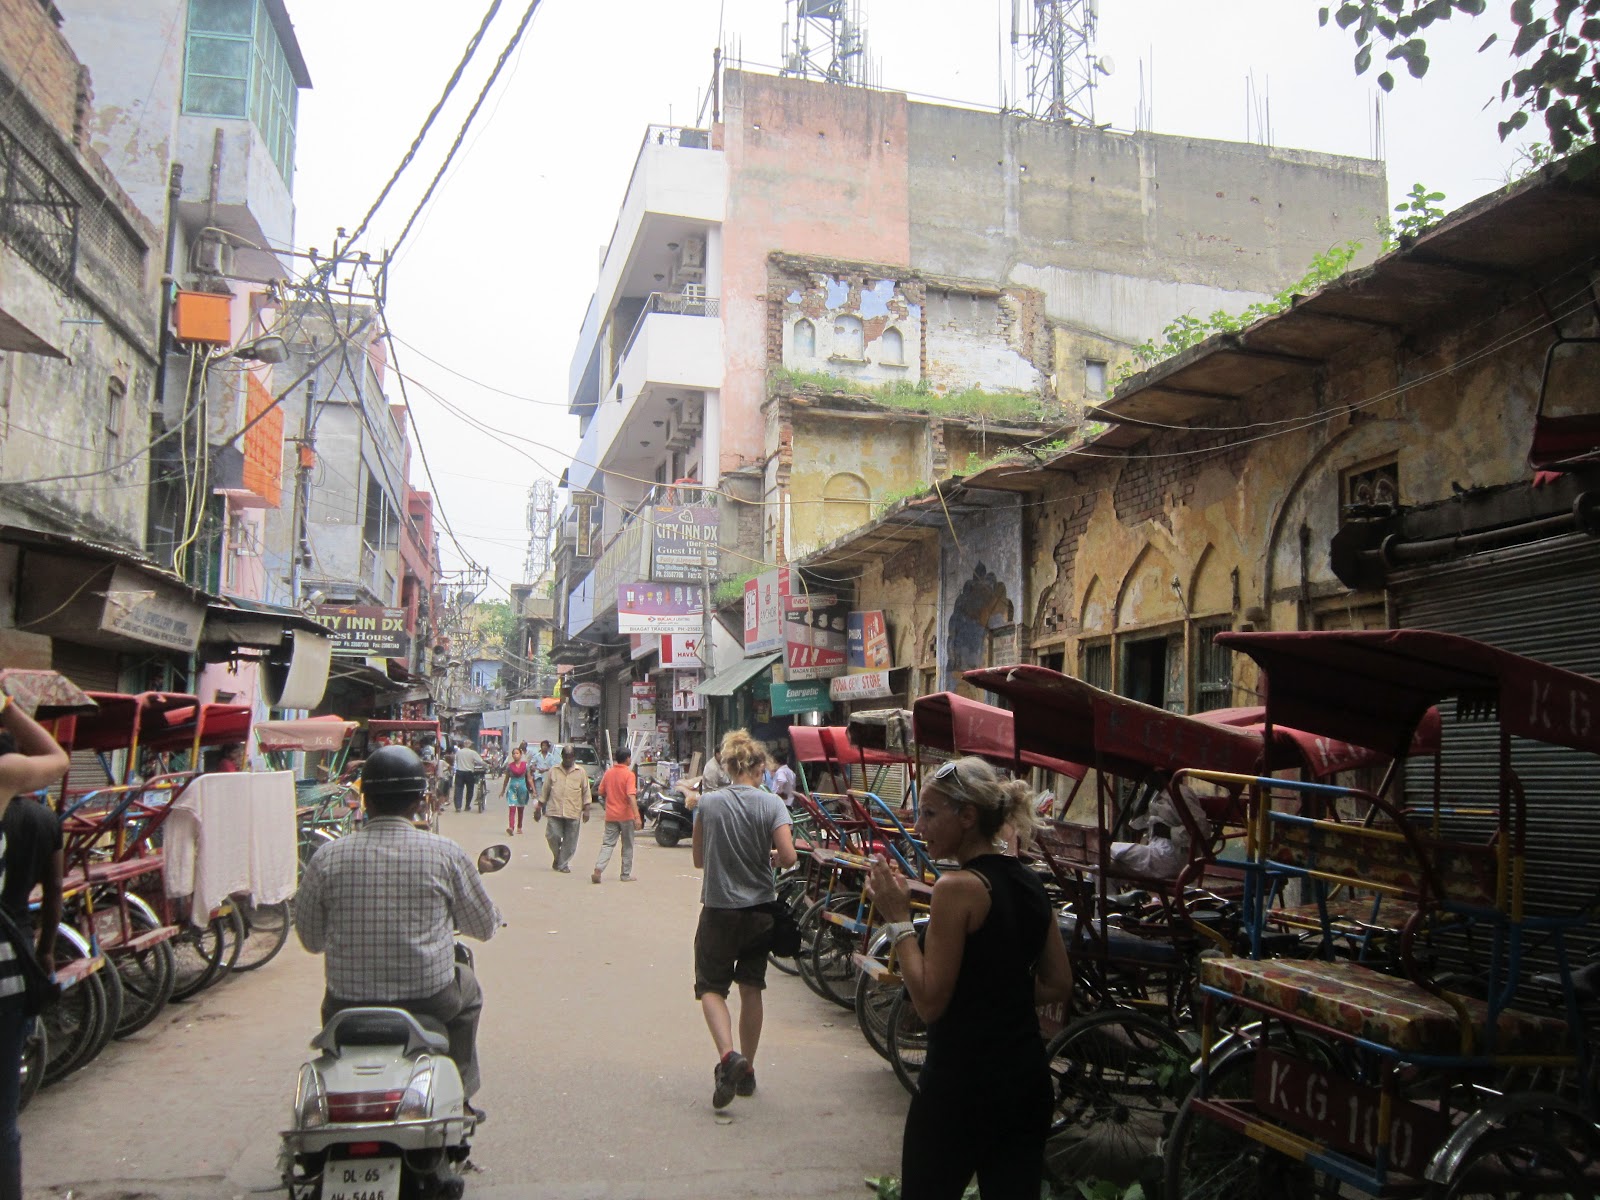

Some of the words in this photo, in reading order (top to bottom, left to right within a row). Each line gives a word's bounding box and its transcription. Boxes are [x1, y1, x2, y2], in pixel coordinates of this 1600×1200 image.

[655, 523, 679, 540] CITY
[681, 525, 700, 540] INN
[703, 525, 718, 541] DX
[657, 546, 686, 555] Guest
[688, 547, 718, 556] Hose
[346, 616, 376, 631] INN
[381, 618, 404, 632] DX
[326, 632, 352, 640] uest
[354, 631, 394, 642] House
[861, 673, 882, 689] STORE
[786, 687, 820, 698] Energetic
